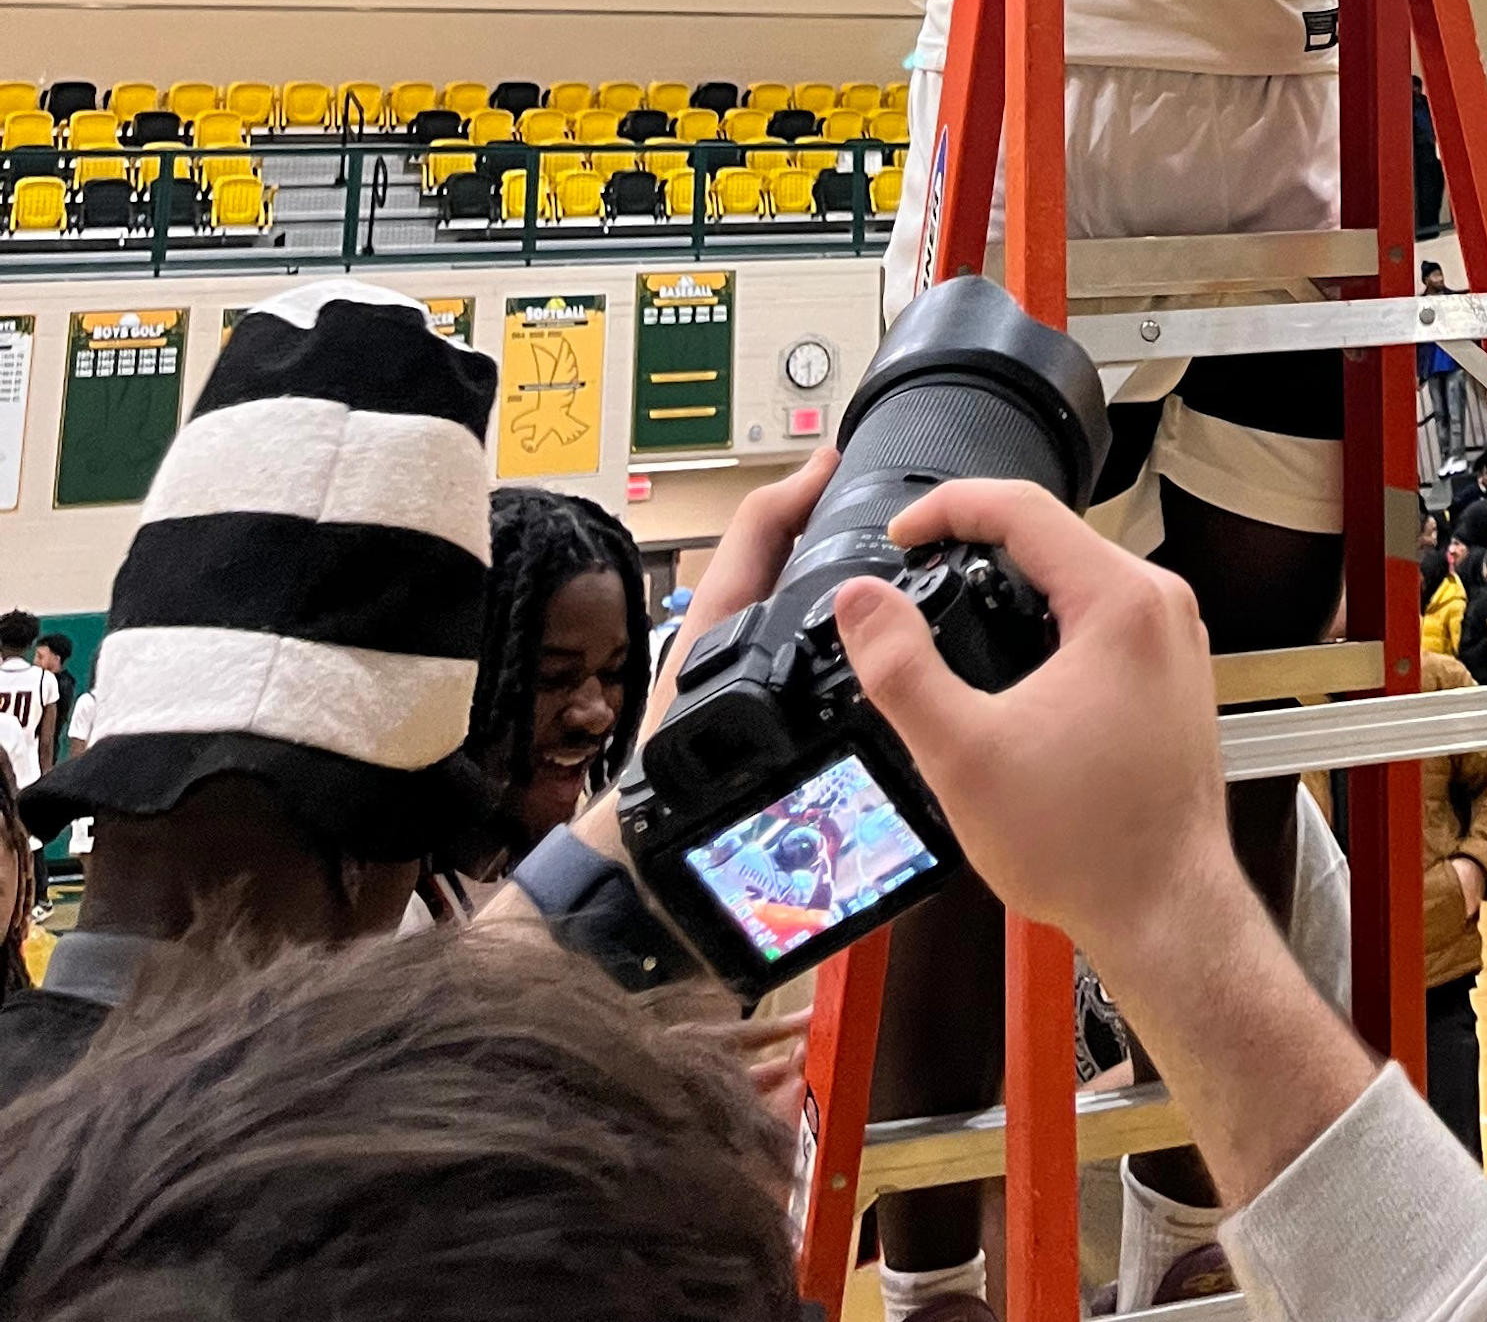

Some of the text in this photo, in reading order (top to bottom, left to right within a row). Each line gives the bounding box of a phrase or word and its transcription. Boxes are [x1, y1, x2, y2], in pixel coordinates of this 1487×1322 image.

[659, 284, 714, 298] BASEBALL
[525, 304, 586, 321] SOFTBALL
[93, 322, 165, 339] BOYS GOLF
